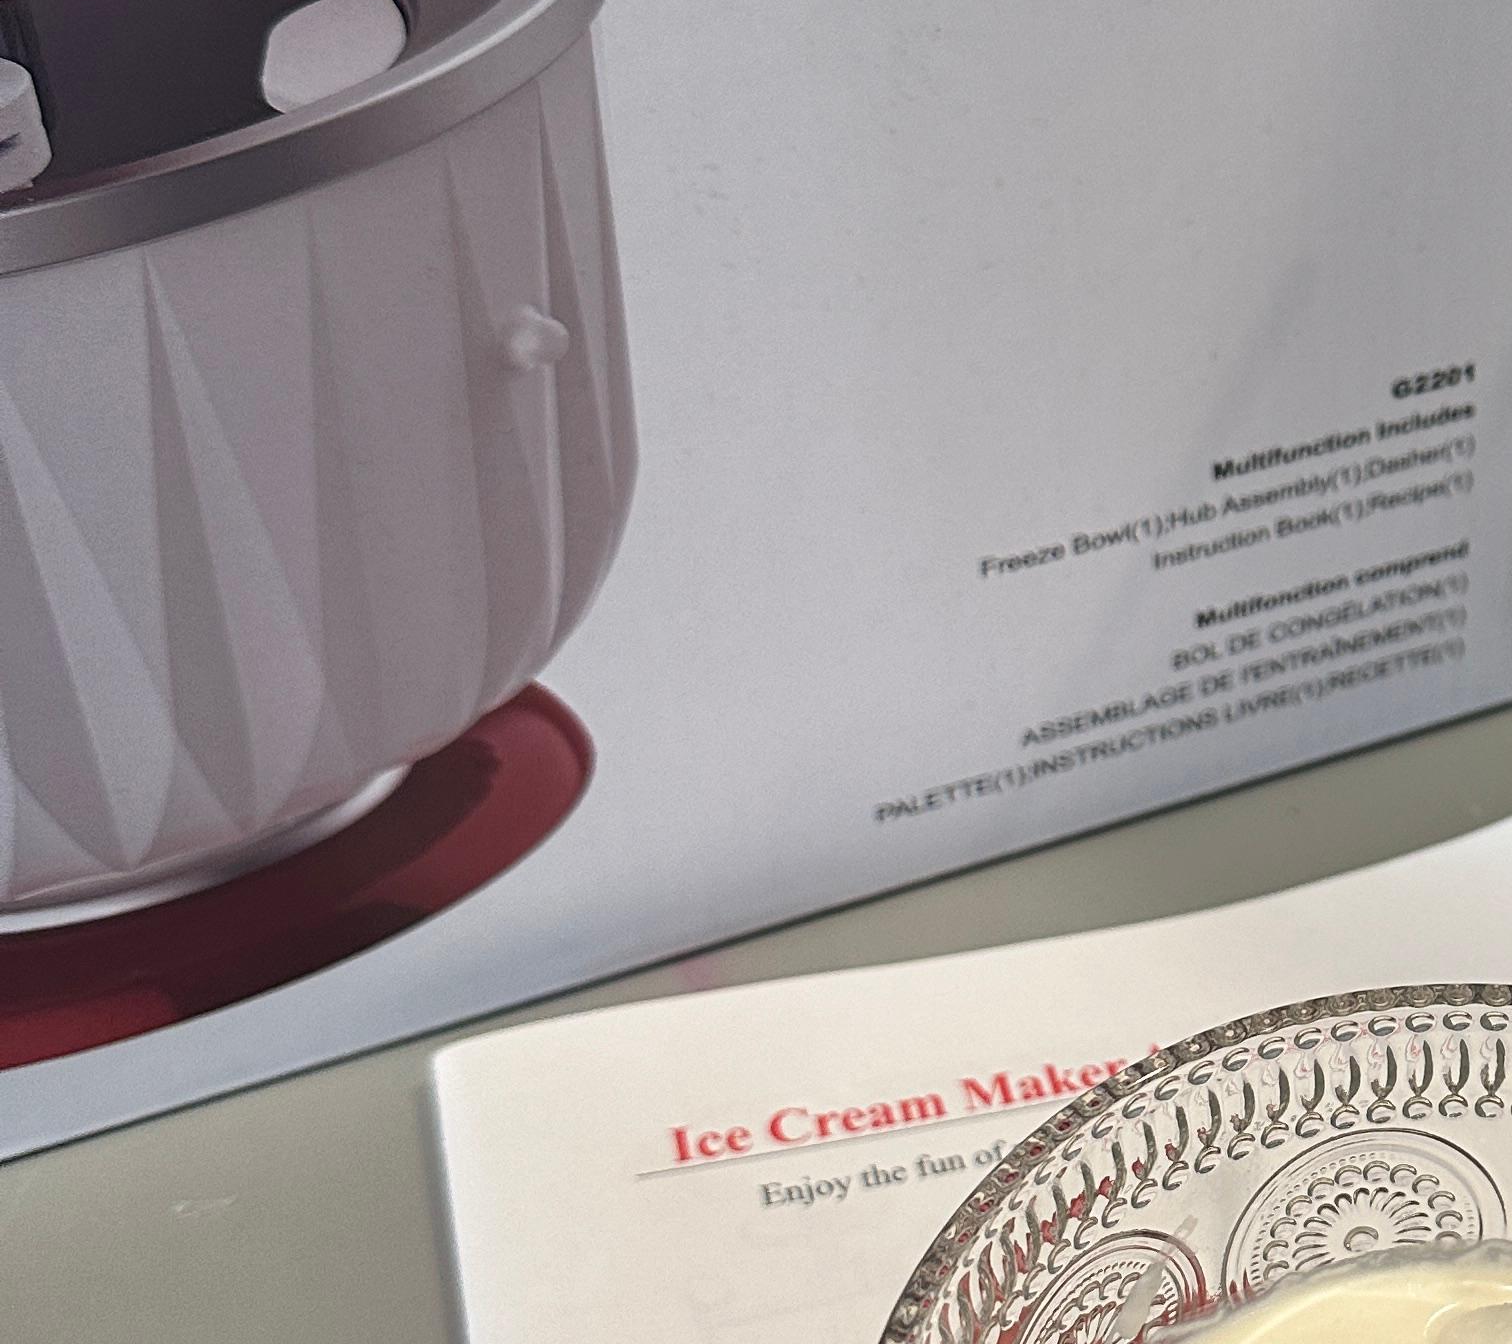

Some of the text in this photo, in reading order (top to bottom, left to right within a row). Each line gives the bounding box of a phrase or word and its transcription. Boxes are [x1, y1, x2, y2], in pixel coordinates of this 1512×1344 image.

[1391, 362, 1476, 400] G2201
[1212, 403, 1476, 481] Multifunction Includes
[979, 544, 1065, 578] Freeze
[1153, 524, 1271, 571] Instruction
[1196, 537, 1470, 629] Multifonction comprend
[1171, 640, 1220, 671] BOL
[1225, 627, 1262, 656] DE
[1021, 681, 1194, 748] ASSEMBLAGE
[1198, 668, 1234, 698] DE
[669, 1060, 1128, 1164] Ice Cream Maker
[760, 1139, 1011, 1210] Enjoy the fun of
